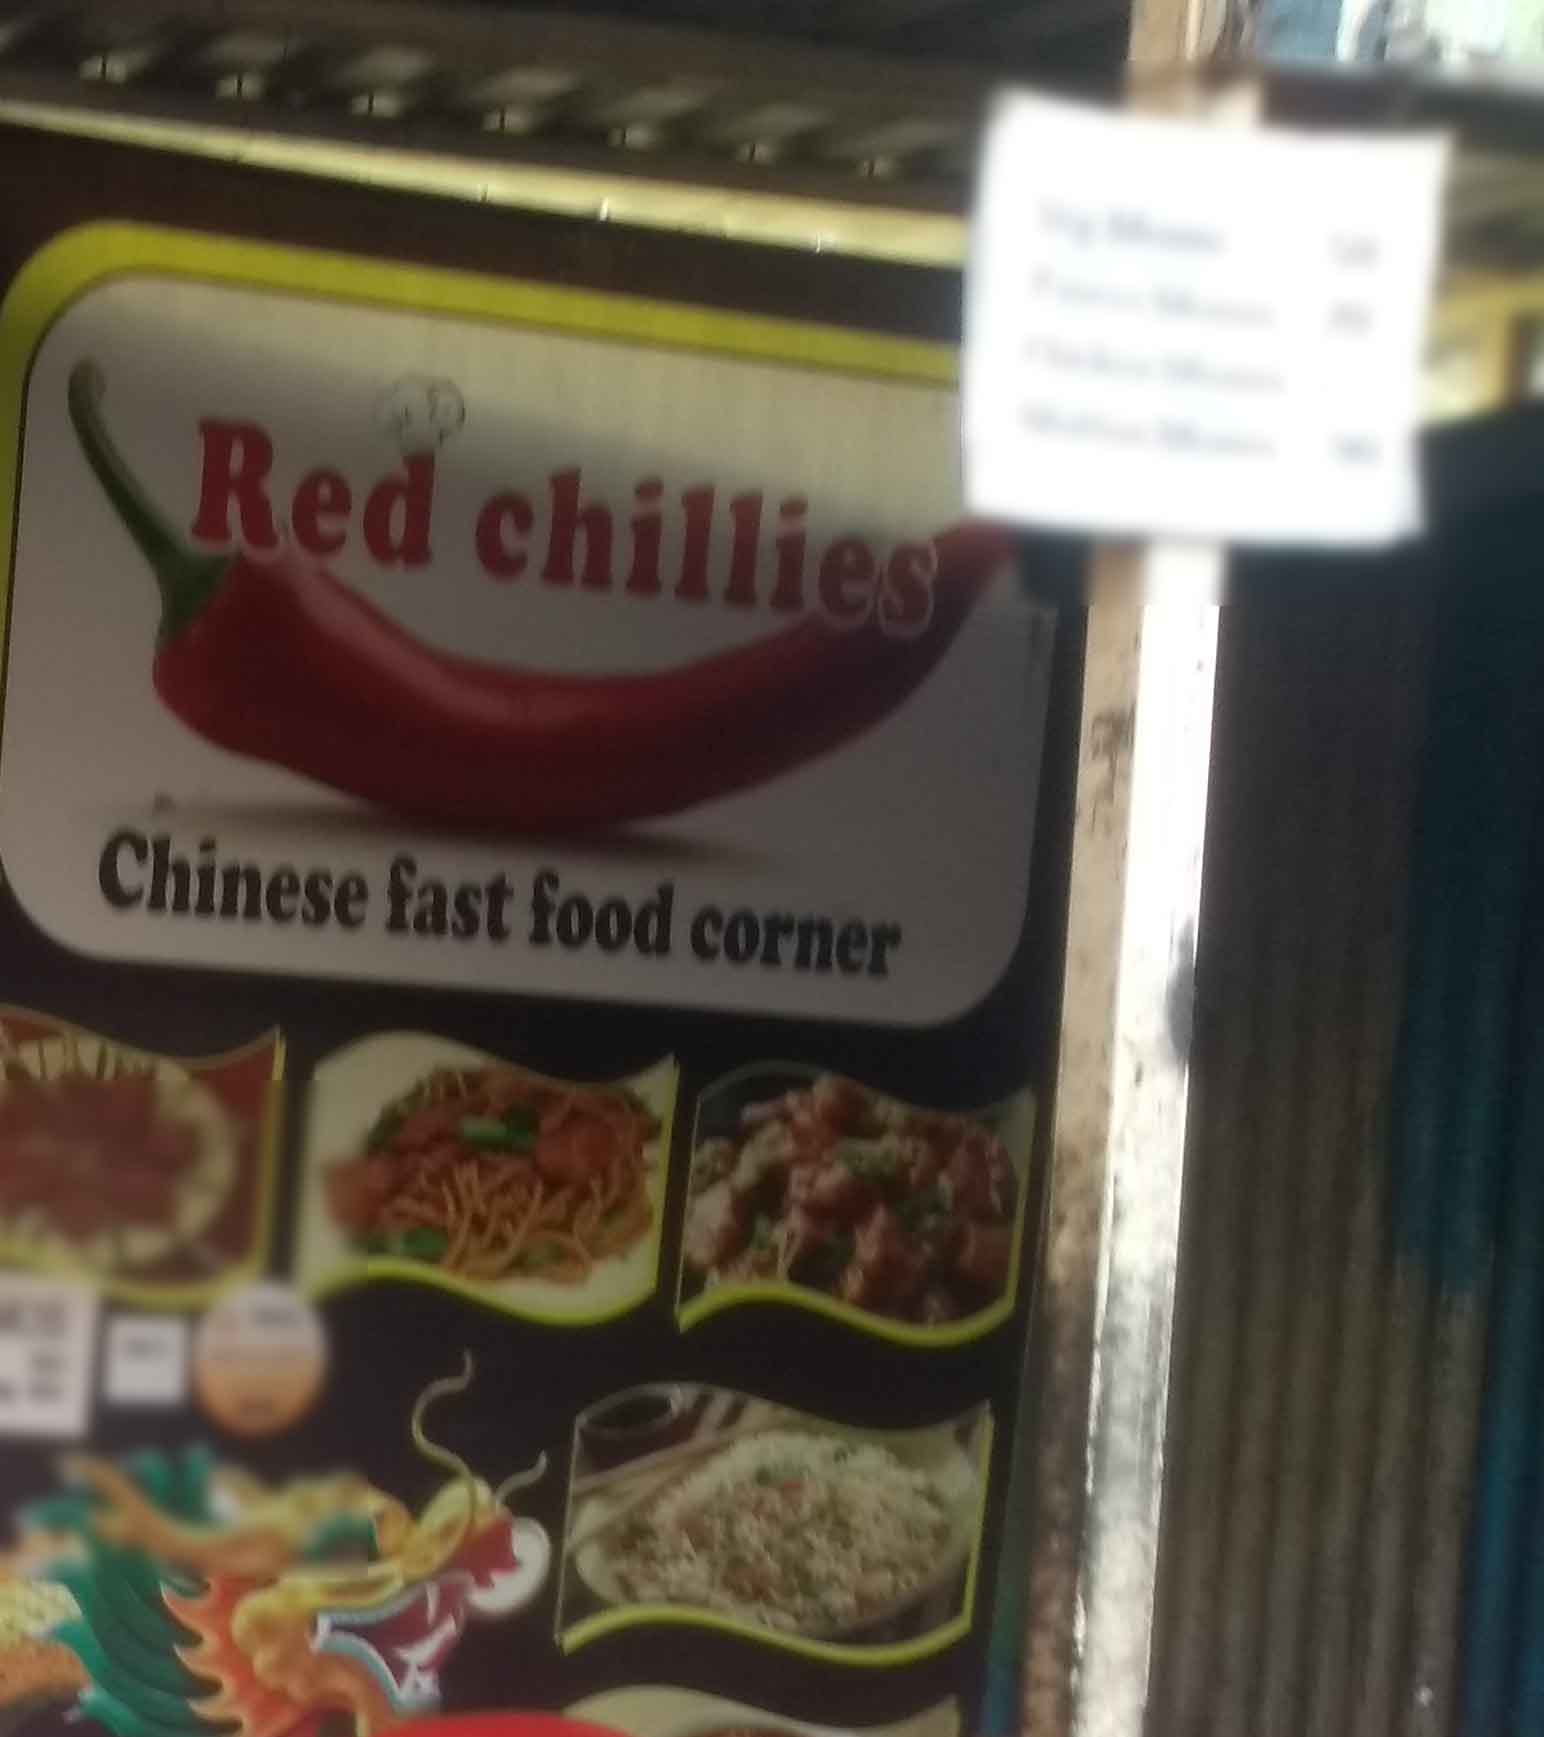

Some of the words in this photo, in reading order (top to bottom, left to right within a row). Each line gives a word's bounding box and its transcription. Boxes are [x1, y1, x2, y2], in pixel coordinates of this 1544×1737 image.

[190, 416, 436, 570] Red
[474, 465, 936, 637] chillies
[98, 826, 369, 928] Chinese
[385, 852, 513, 940] fast
[529, 867, 674, 957] food
[690, 905, 902, 978] corner
